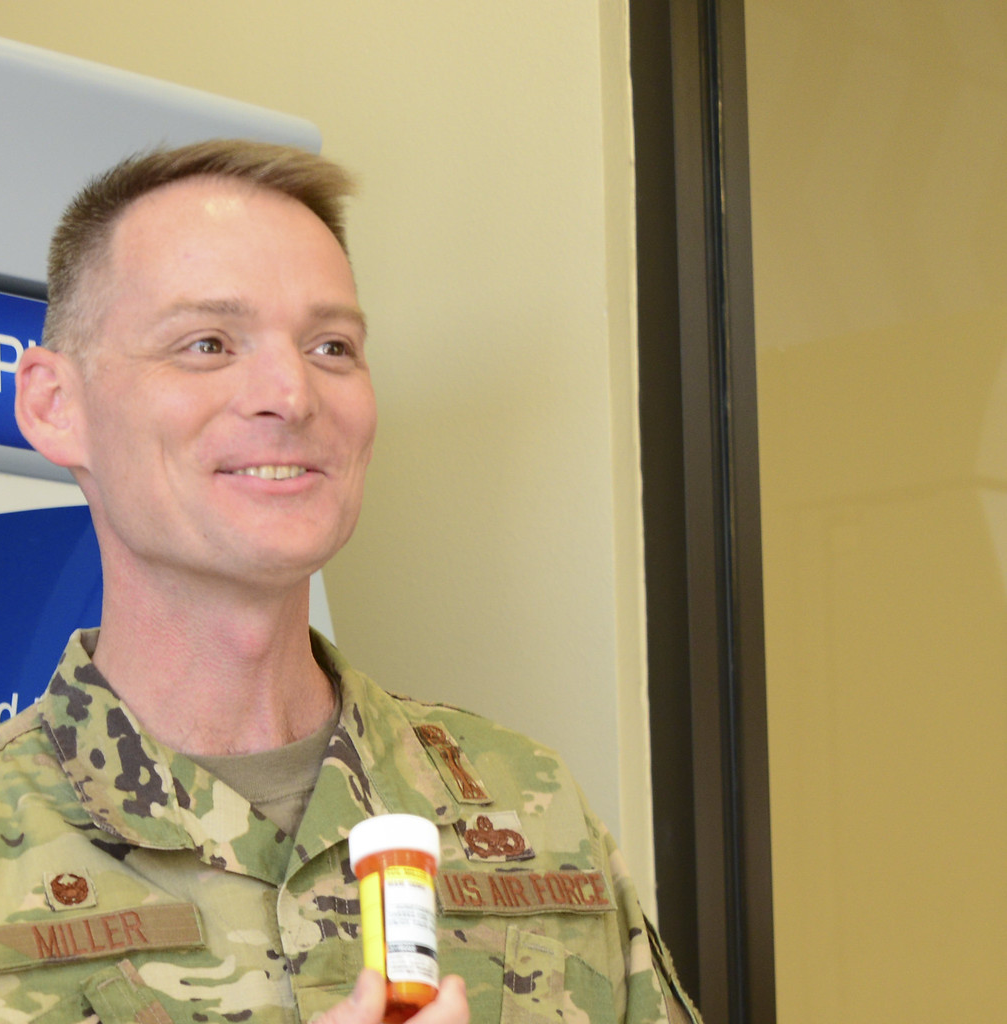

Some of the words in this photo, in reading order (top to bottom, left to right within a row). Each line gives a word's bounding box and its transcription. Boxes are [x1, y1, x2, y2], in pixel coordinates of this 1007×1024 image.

[488, 874, 531, 907] AIR
[529, 873, 609, 905] FORCE
[32, 911, 148, 958] MILLER
